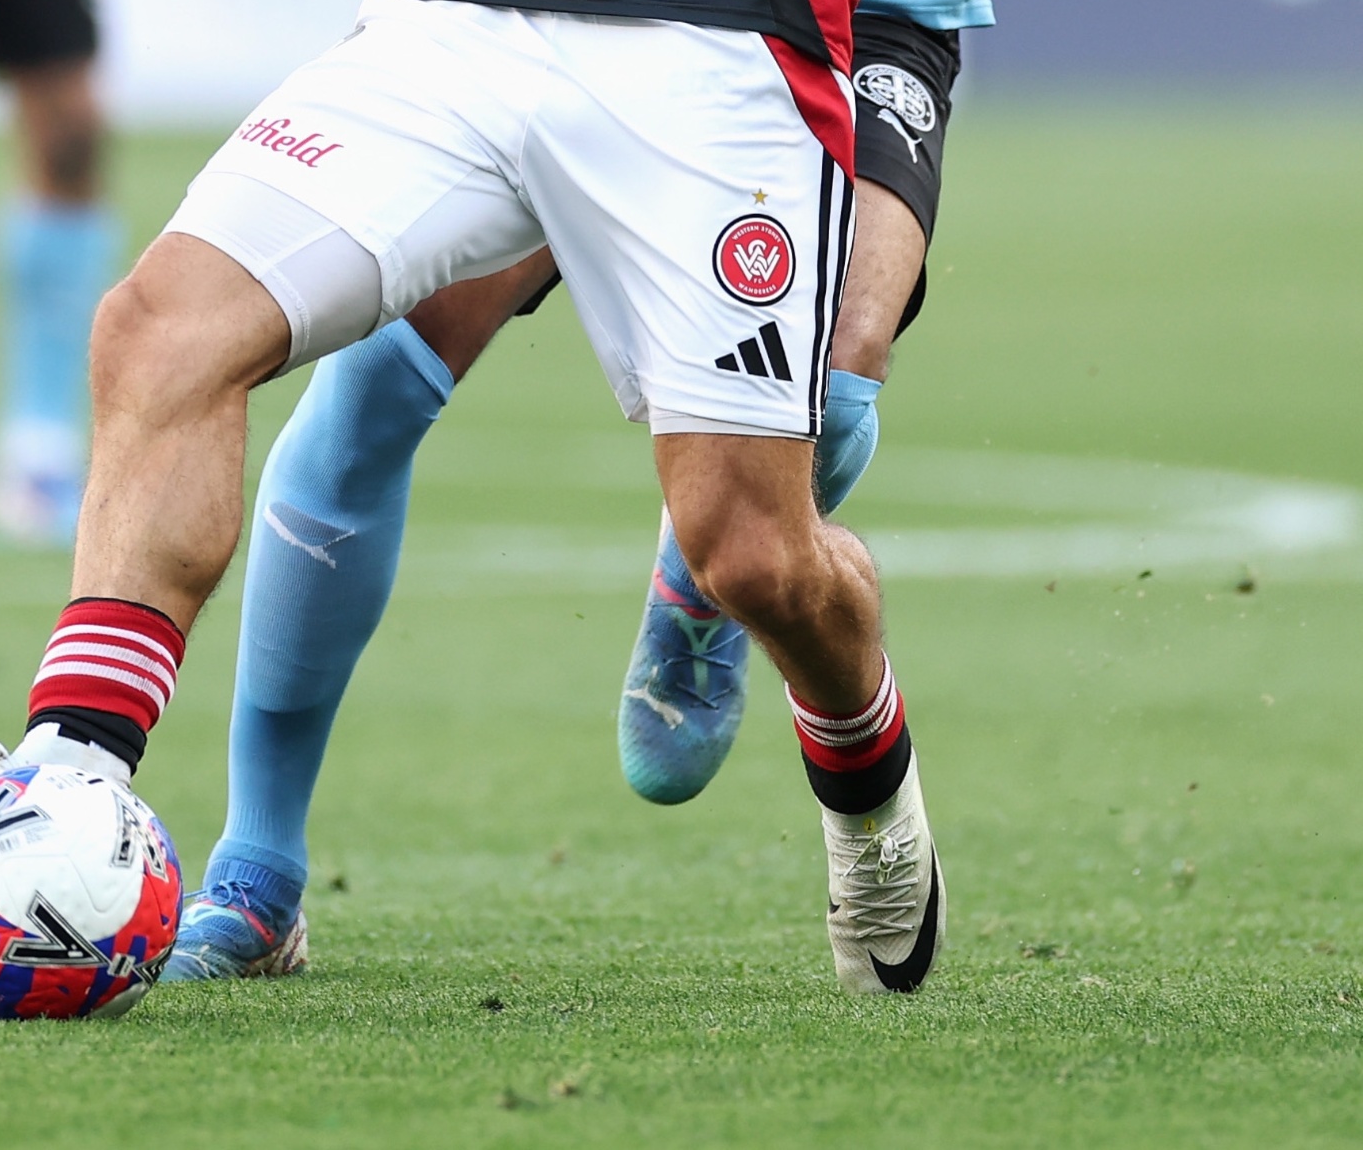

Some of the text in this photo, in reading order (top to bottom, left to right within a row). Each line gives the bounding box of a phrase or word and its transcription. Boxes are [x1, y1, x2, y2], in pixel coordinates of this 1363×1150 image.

[237, 118, 344, 168] tfield
[732, 225, 782, 243] WESTERN SYDNEY
[738, 281, 777, 295] WANDERERS
